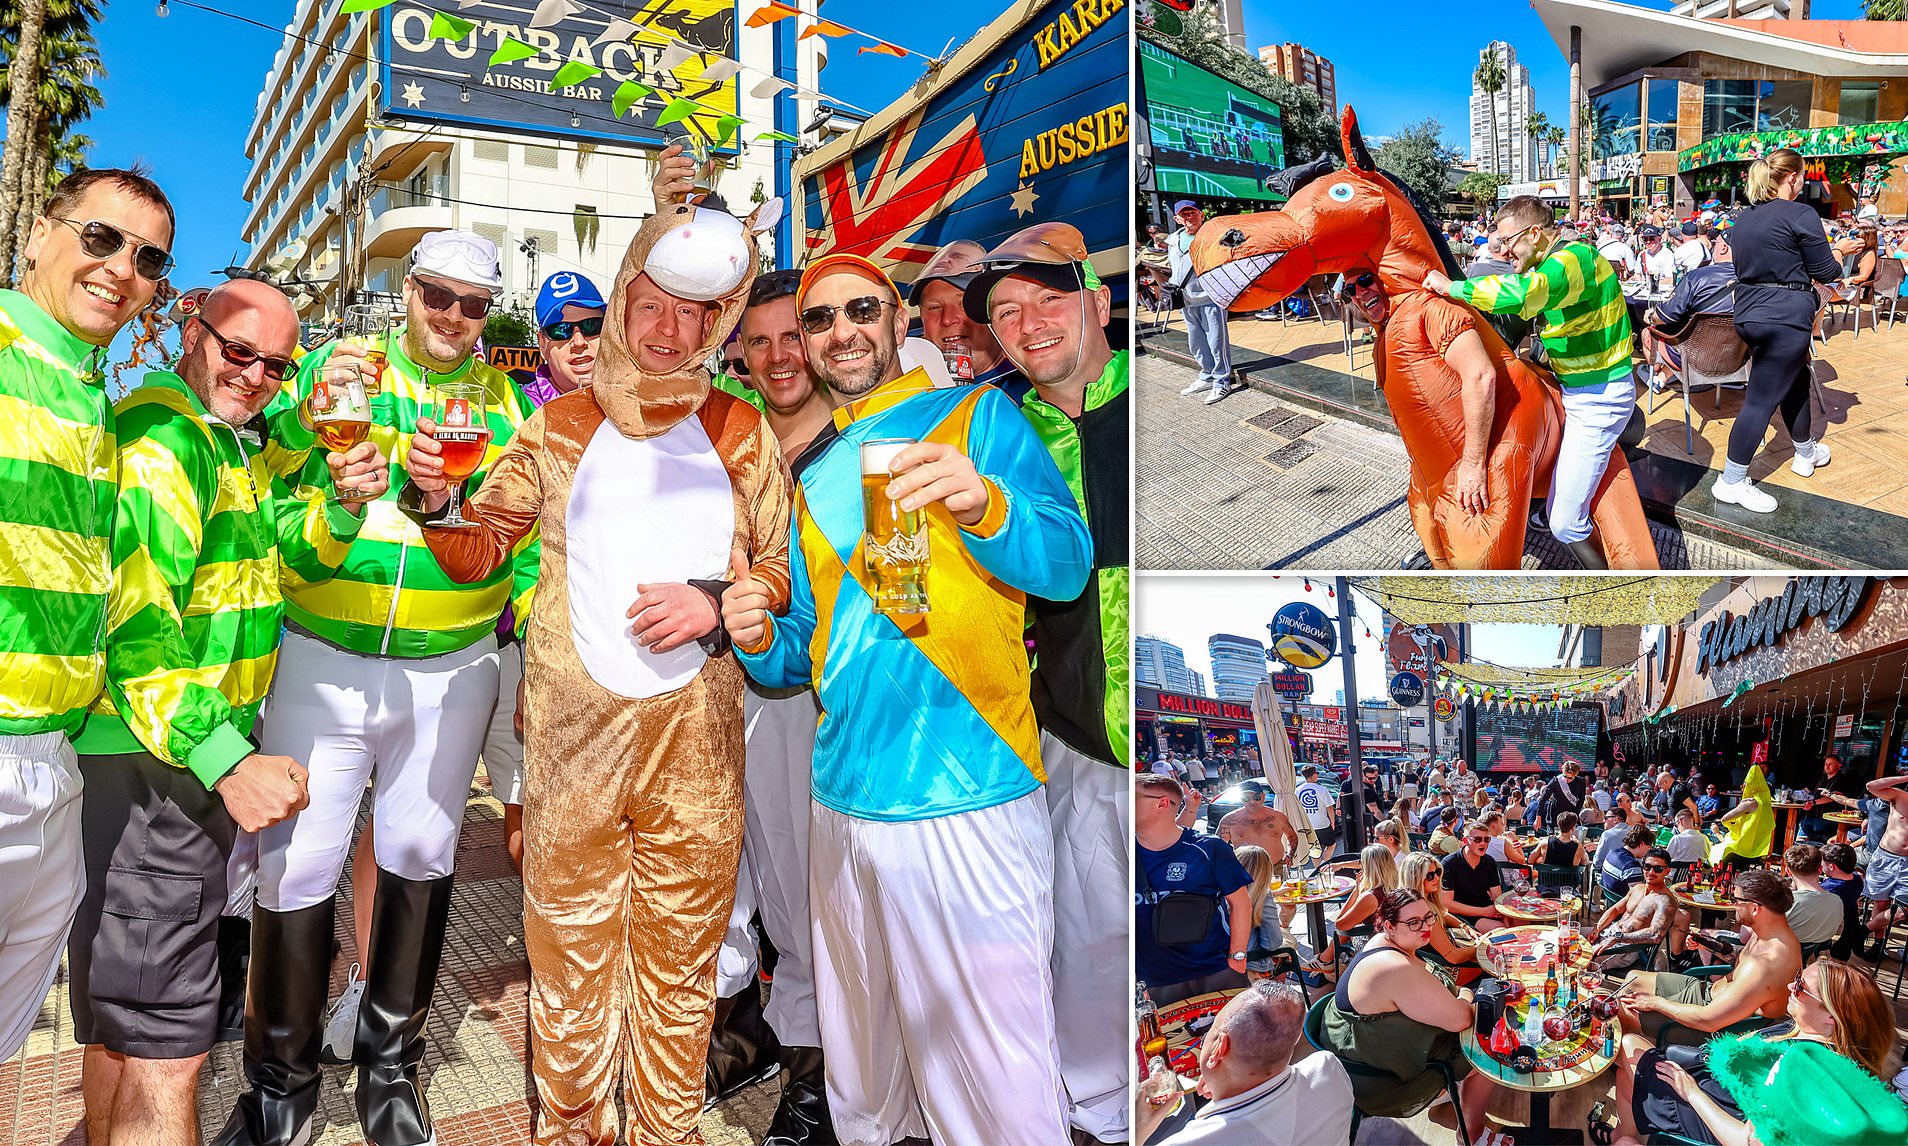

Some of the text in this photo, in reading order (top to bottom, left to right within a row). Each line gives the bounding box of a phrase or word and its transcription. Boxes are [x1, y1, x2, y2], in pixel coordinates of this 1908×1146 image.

[391, 8, 684, 91] OUTBACK
[482, 72, 602, 101] AUSSIE BAR
[1019, 102, 1128, 179] AUSSIE
[492, 348, 541, 368] ATM
[1277, 614, 1326, 640] STRONGBOW
[1695, 576, 1868, 675] Flaming
[1275, 675, 1306, 683] MILLION
[1391, 687, 1421, 697] GUINNESS
[1158, 693, 1220, 717] MILLION
